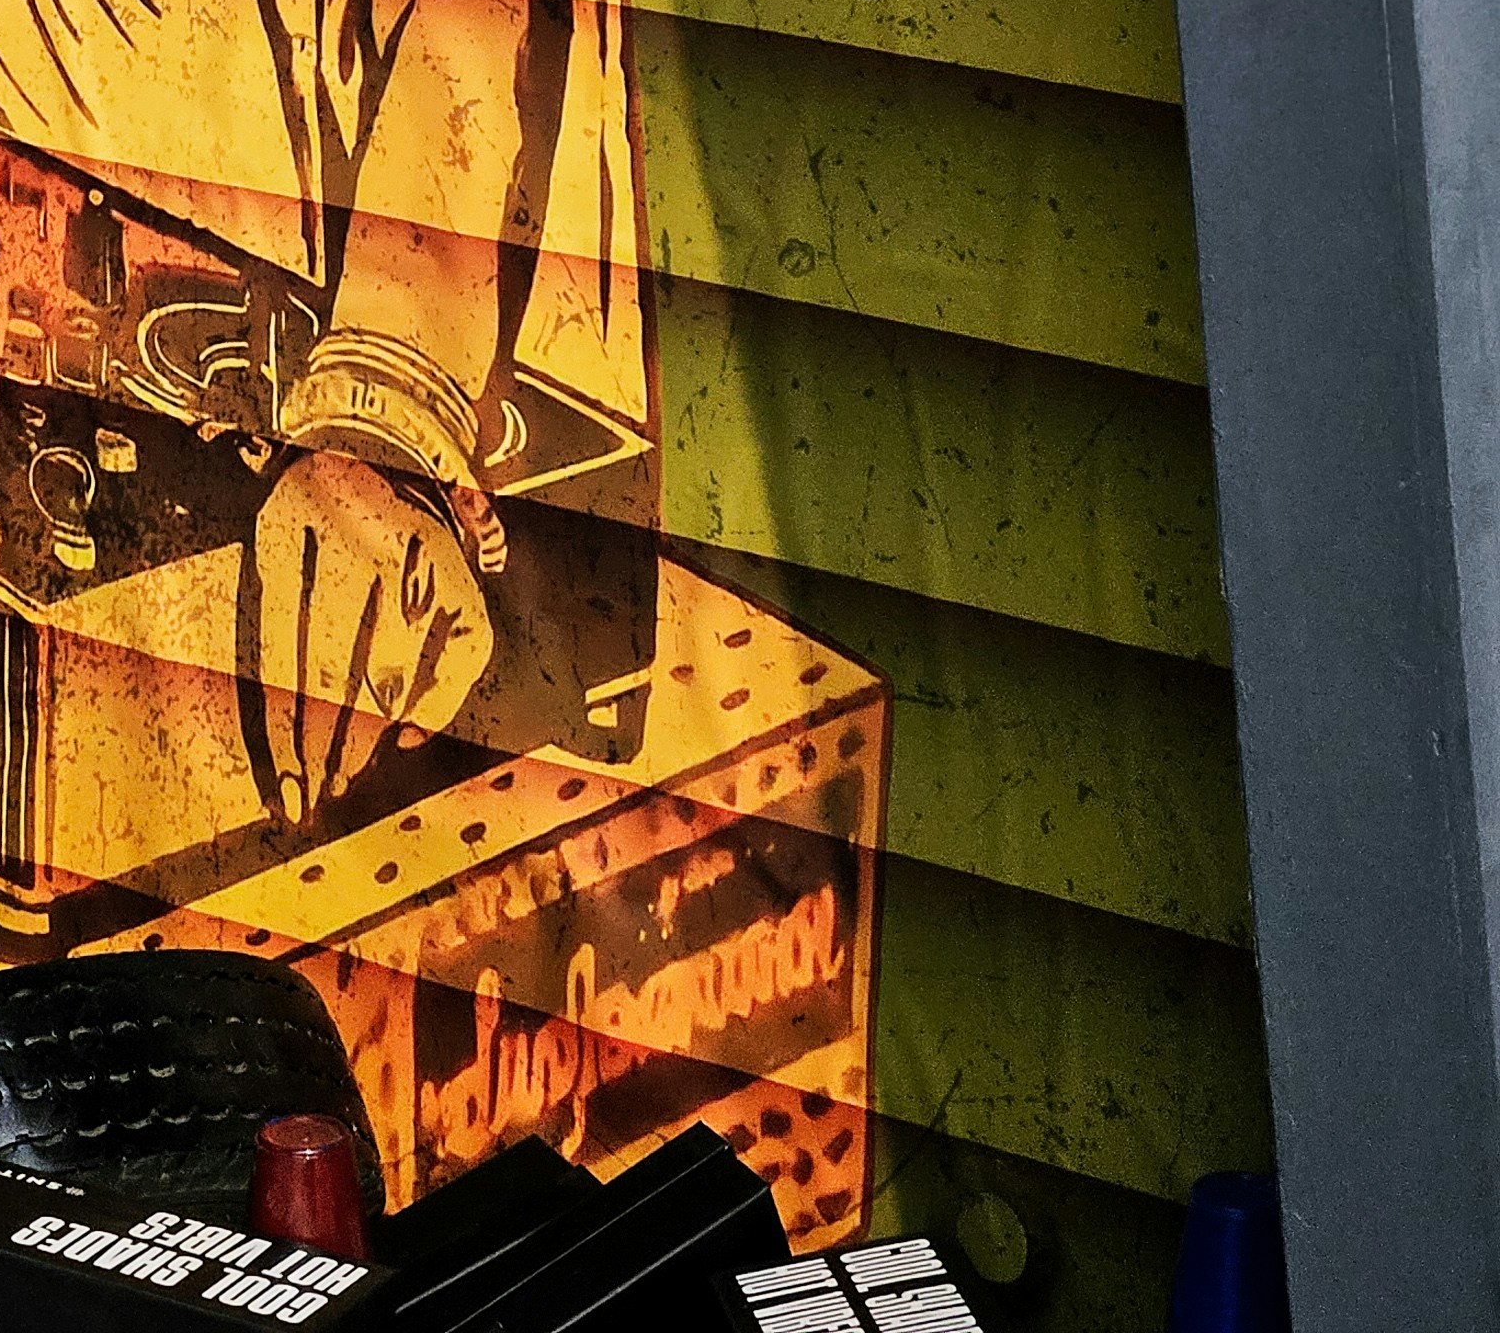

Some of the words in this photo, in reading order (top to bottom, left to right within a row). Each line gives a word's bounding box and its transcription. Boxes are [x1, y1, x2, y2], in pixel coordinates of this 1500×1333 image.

[10, 1216, 204, 1287] SHADES
[128, 1212, 272, 1268] VIBES
[839, 1238, 948, 1293] COOL
[201, 1266, 329, 1324] COOL
[260, 1250, 369, 1296] HOT
[735, 1258, 839, 1303] HOT
